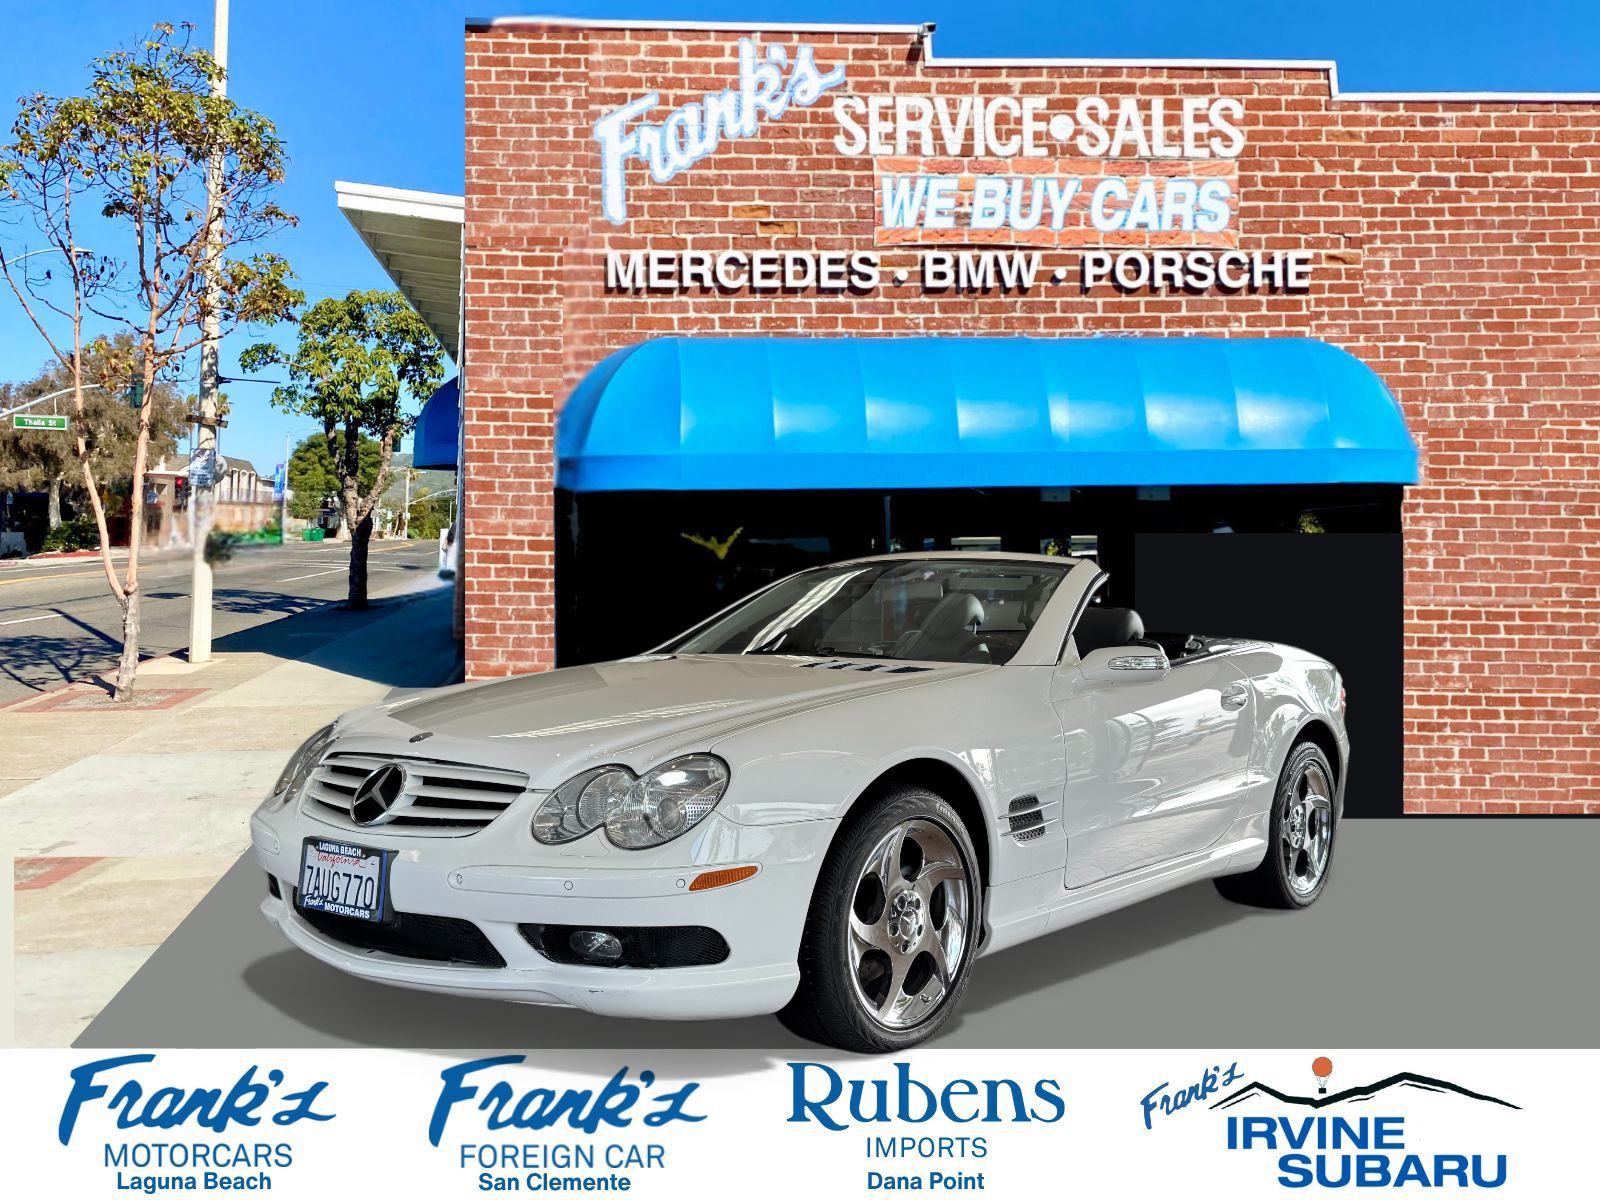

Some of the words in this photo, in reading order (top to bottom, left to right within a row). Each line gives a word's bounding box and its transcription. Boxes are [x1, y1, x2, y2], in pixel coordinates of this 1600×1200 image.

[594, 38, 846, 225] Frank's
[879, 175, 960, 230] WE
[969, 176, 1080, 231] BUY
[1089, 177, 1232, 233] CARS
[605, 250, 879, 292] MERCEDES
[922, 250, 1041, 291] BMW
[1083, 250, 1314, 290] PORSCHE
[24, 418, 46, 426] Thalia
[48, 419, 57, 427] St
[319, 841, 340, 854] LAGUNA
[340, 845, 361, 857] BEACH
[305, 864, 375, 909] 7AUG770
[324, 902, 370, 919] MOTORCARS
